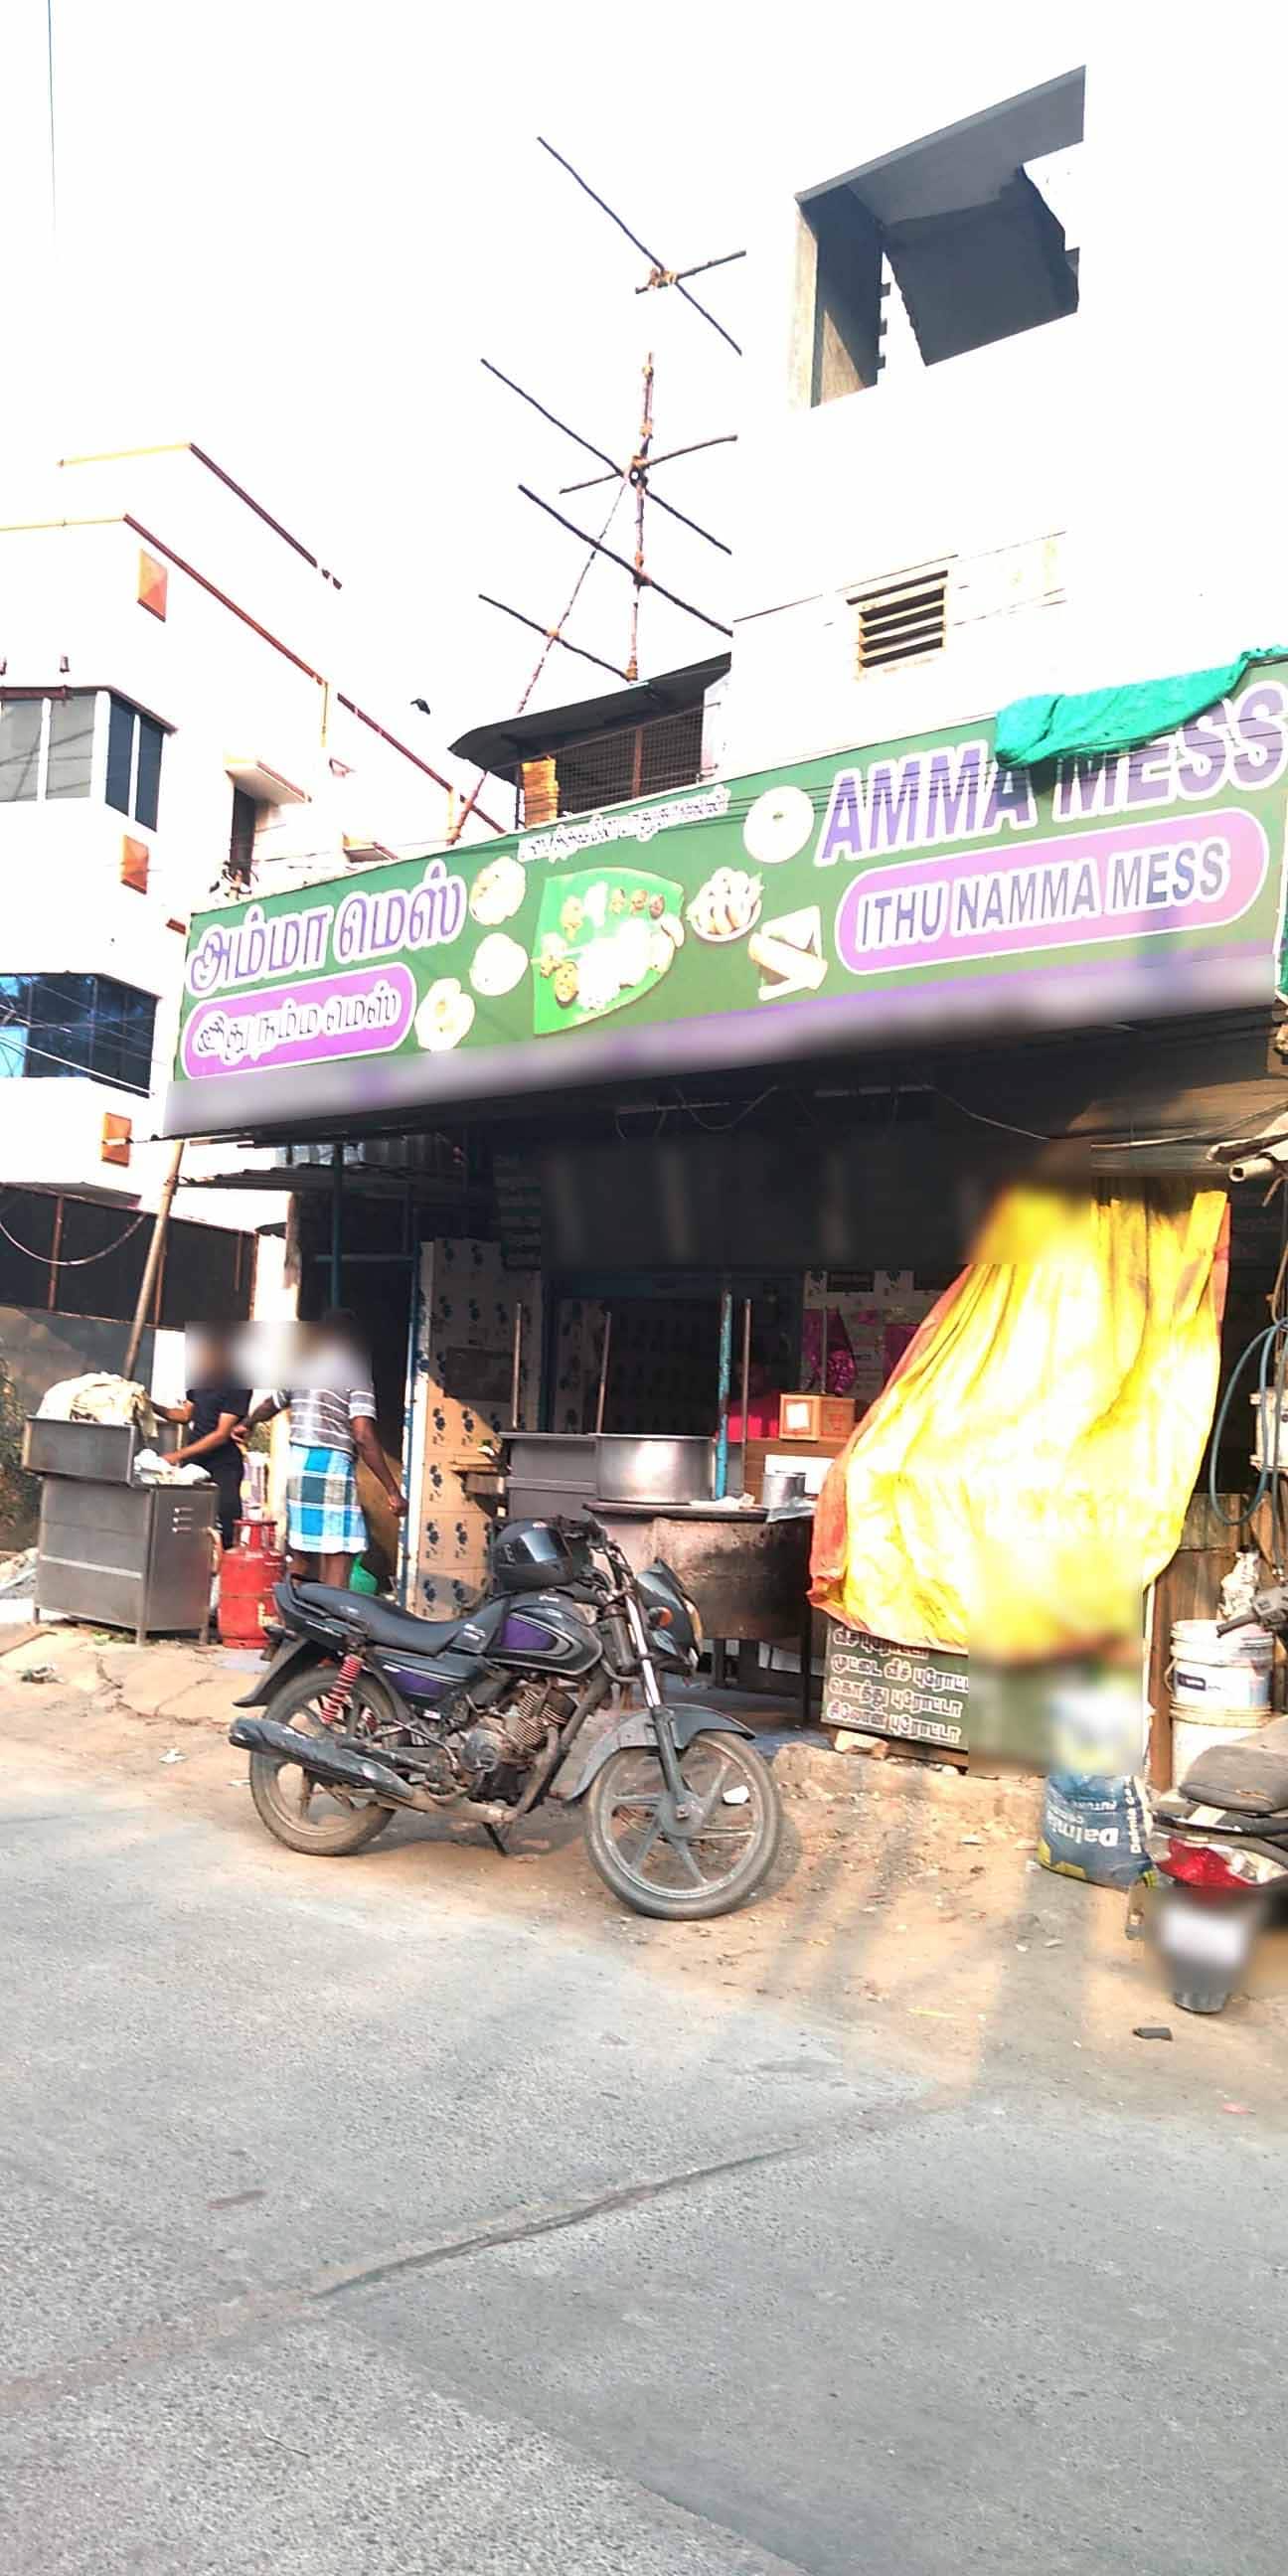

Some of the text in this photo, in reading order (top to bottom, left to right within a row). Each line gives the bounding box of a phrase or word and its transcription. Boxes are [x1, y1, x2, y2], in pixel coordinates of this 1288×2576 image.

[817, 741, 1038, 866] AMMA
[1052, 681, 1288, 823] MESS
[187, 863, 463, 994] அம்மா மெஸ்
[859, 840, 1226, 949] ITHU NAMMA MESS
[196, 984, 400, 1062] இது நம்ம மெஸ்
